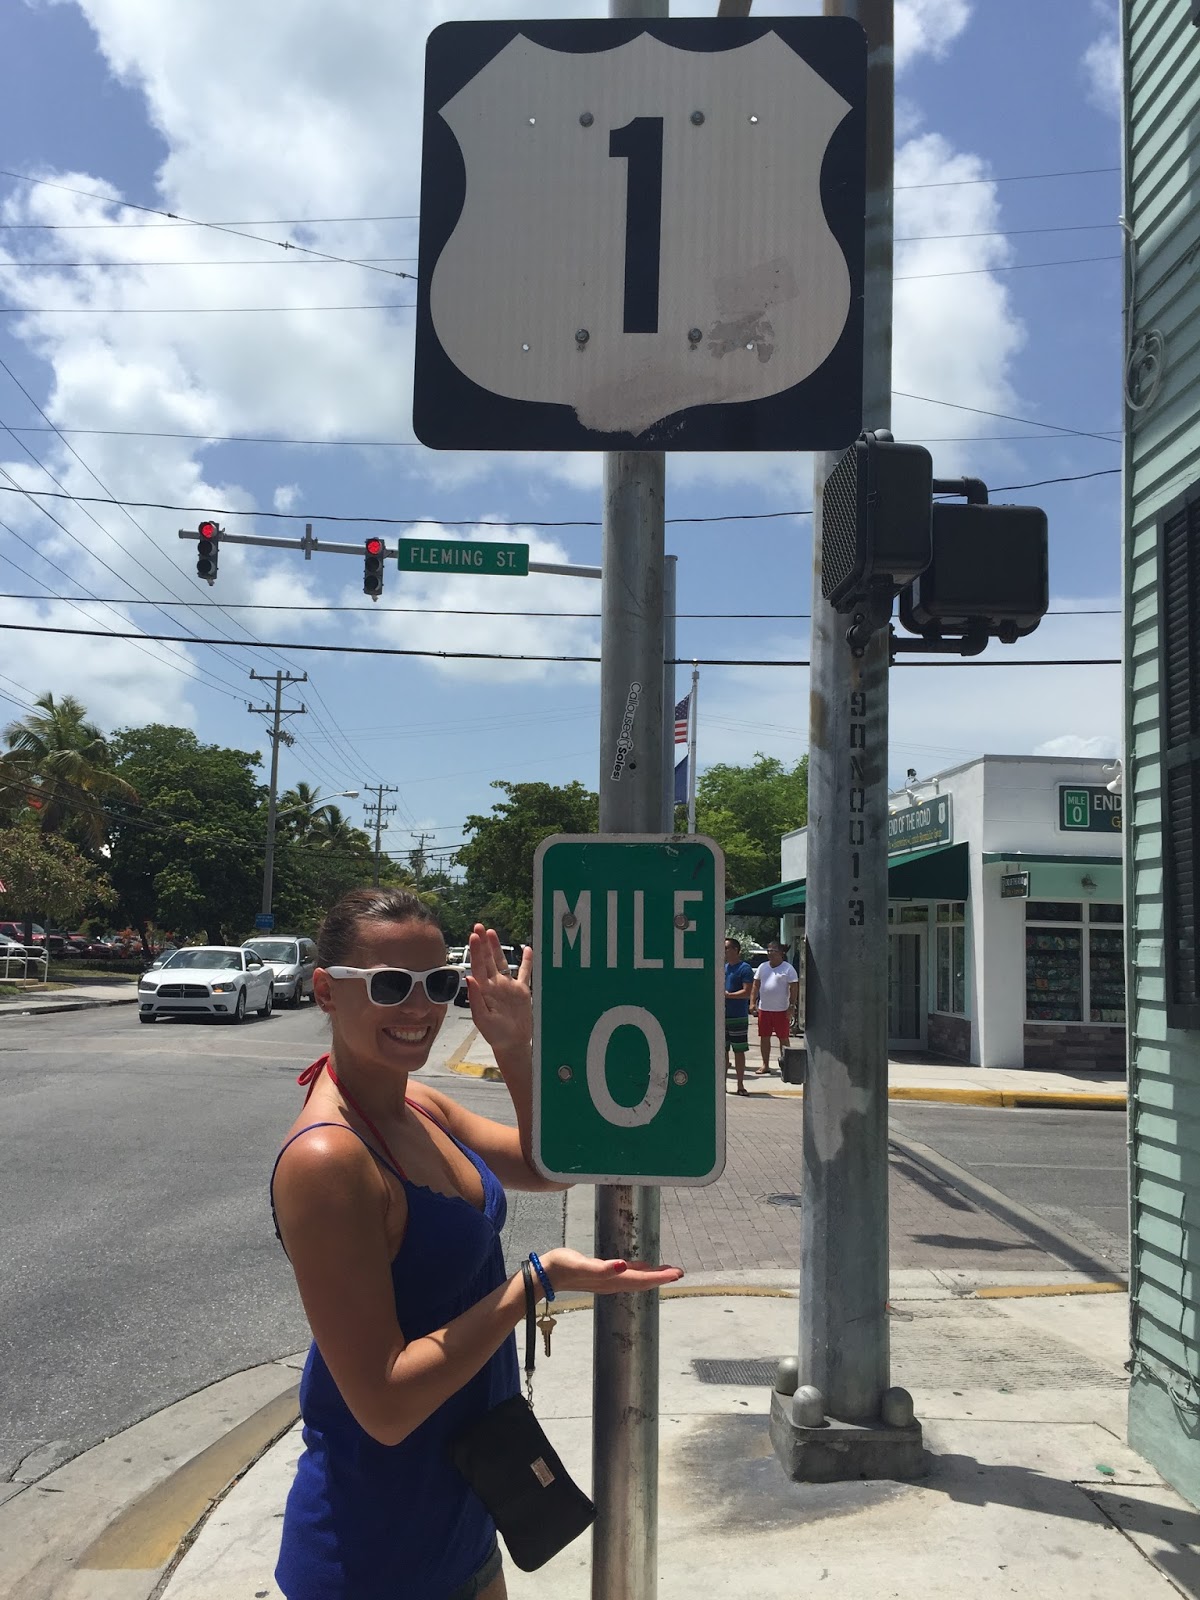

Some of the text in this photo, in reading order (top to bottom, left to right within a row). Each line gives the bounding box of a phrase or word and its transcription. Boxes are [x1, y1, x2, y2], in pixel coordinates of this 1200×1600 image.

[609, 117, 664, 333] 1
[410, 547, 517, 568] FLEMING ST.
[1067, 796, 1086, 806] MILE
[1093, 794, 1122, 812] END
[888, 818, 898, 837] END
[898, 815, 905, 834] OF
[905, 812, 916, 832] THE
[915, 807, 931, 829] ROAD
[1072, 806, 1082, 823] 0
[552, 890, 705, 970] MILE
[586, 1004, 669, 1128] 0
